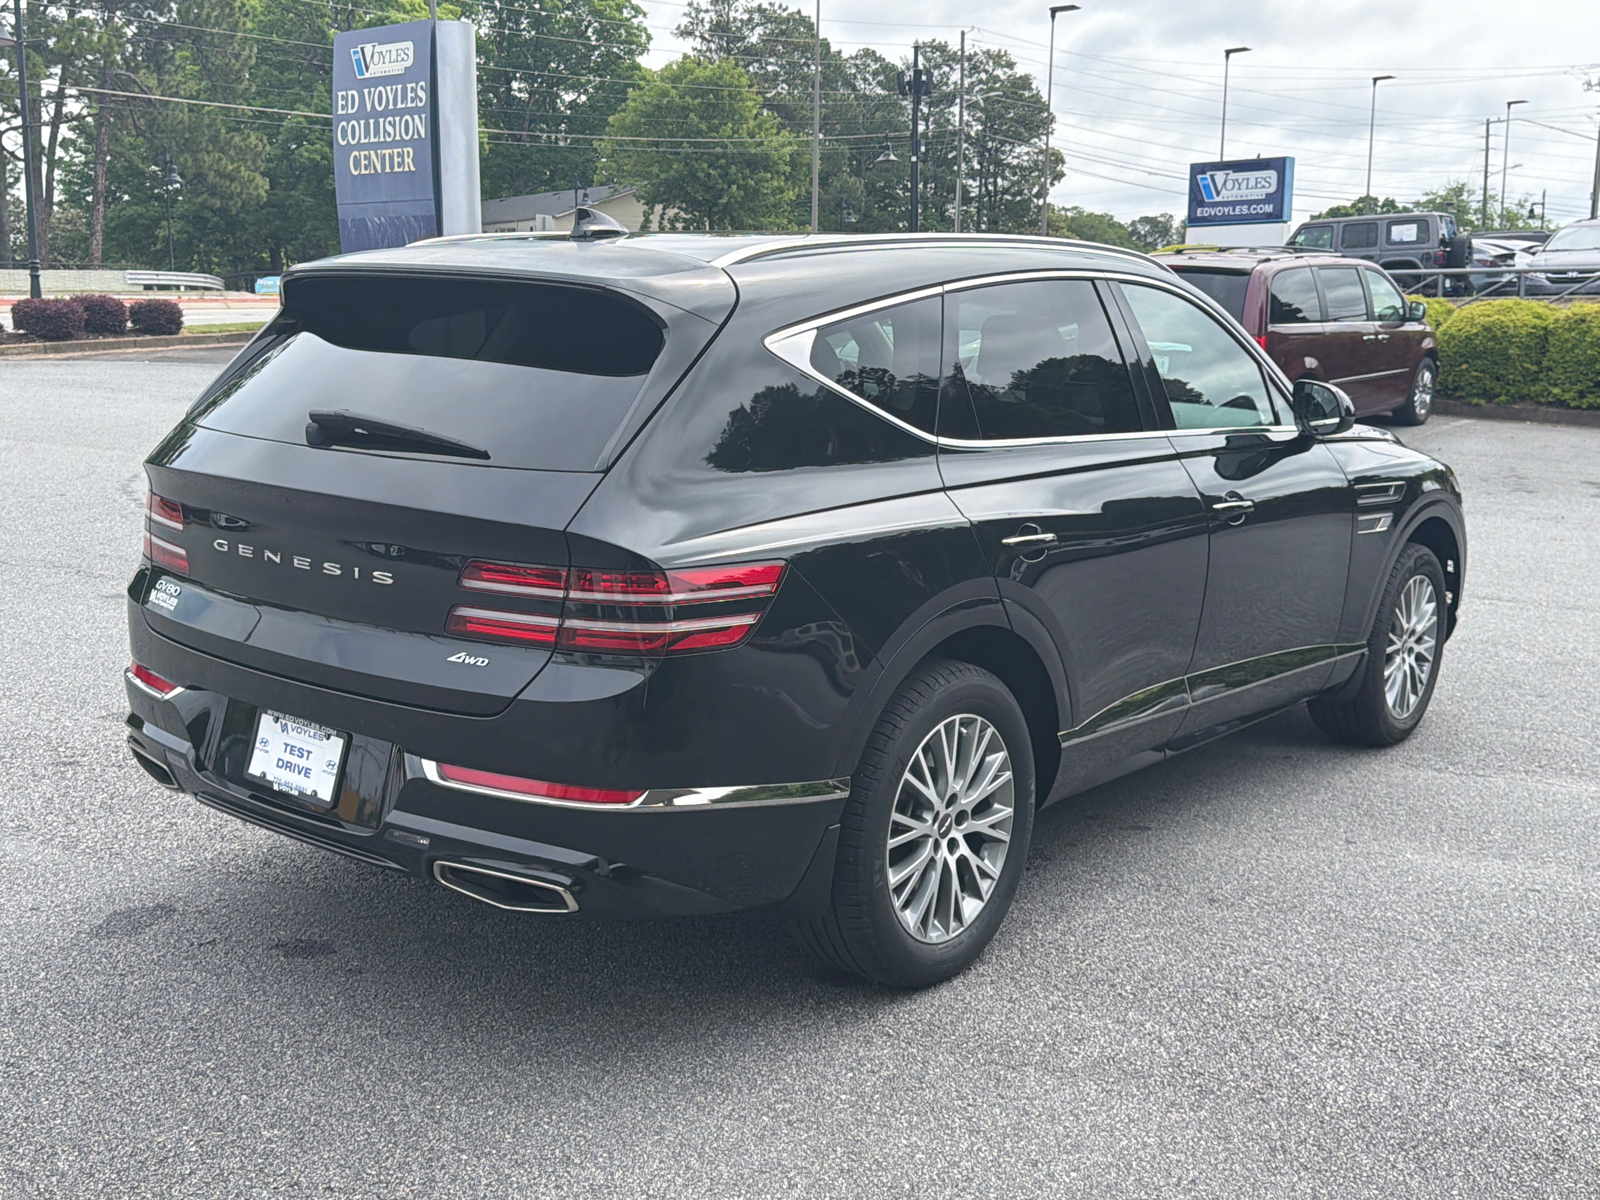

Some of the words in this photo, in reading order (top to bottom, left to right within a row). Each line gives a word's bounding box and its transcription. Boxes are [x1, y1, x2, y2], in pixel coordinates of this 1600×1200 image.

[360, 45, 410, 73] VOYLES
[369, 68, 403, 76] AUTOMOTIVE
[337, 90, 359, 115] ED
[363, 81, 427, 112] VOYLES
[337, 113, 427, 146] COLLISION
[350, 147, 416, 176] CENTER
[1209, 172, 1272, 198] VOYLES
[1196, 204, 1274, 217] EDVOYLES.COM
[213, 539, 394, 585] GENESIS
[156, 580, 180, 596] GV80
[446, 652, 489, 667] 4WD
[267, 709, 337, 736] WWW.EDVOYLES.COM
[290, 724, 324, 741] VOYLES
[283, 742, 313, 761] TEST
[276, 757, 313, 779] DRIVE
